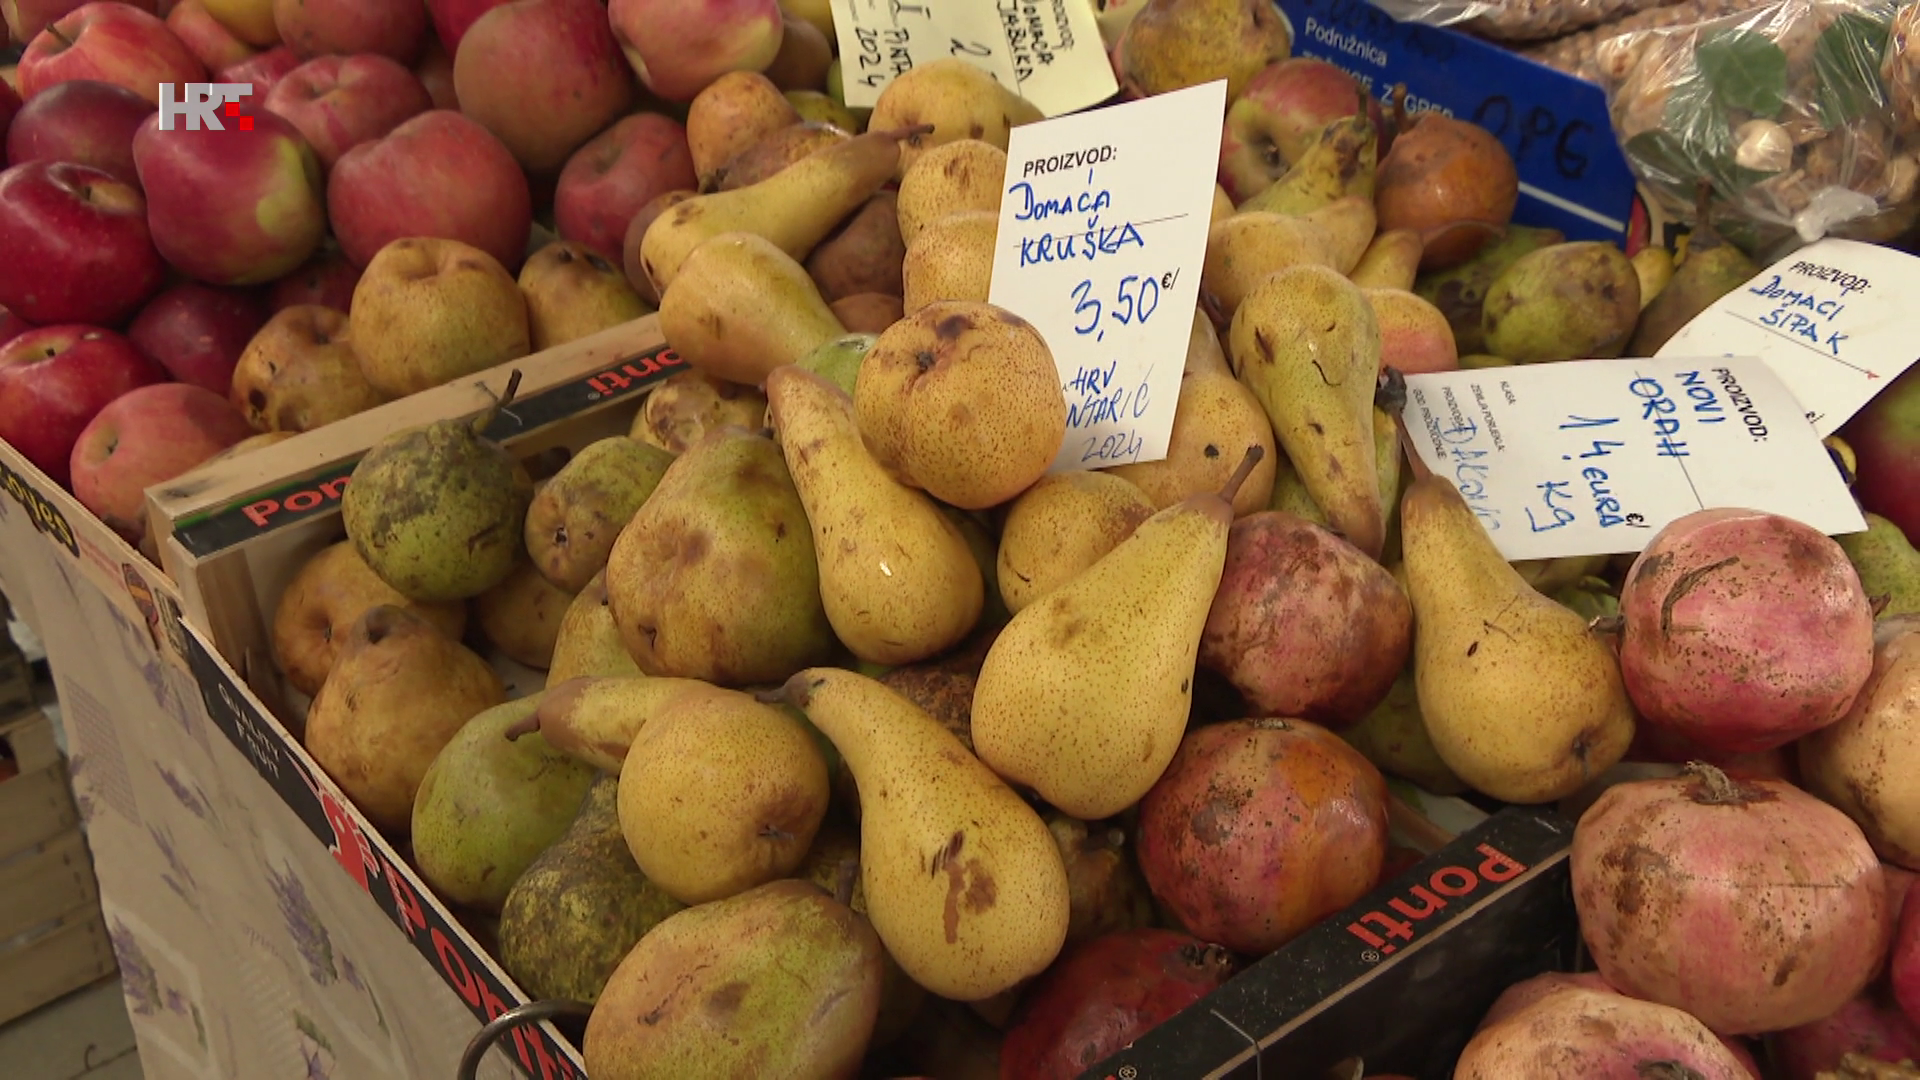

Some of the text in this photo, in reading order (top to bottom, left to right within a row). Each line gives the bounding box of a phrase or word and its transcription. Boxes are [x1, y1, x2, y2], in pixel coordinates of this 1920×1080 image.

[855, 26, 885, 88] 2024
[1304, 16, 1389, 67] Podružnica
[1023, 144, 1118, 179] PROIZVOD:
[1019, 214, 1145, 268] KRUŠKA
[1788, 260, 1872, 295] PROIZVOD:
[1070, 274, 1160, 343] 3,50
[586, 348, 684, 397] onti
[1065, 362, 1154, 429] NTARIĆ
[1674, 370, 1727, 423] NOVI
[1628, 376, 1691, 459] ORAH
[1710, 366, 1769, 443] PROIZVOD:
[1080, 428, 1143, 465] 2024
[242, 474, 351, 528] Pon
[235, 719, 281, 780] FRUIT
